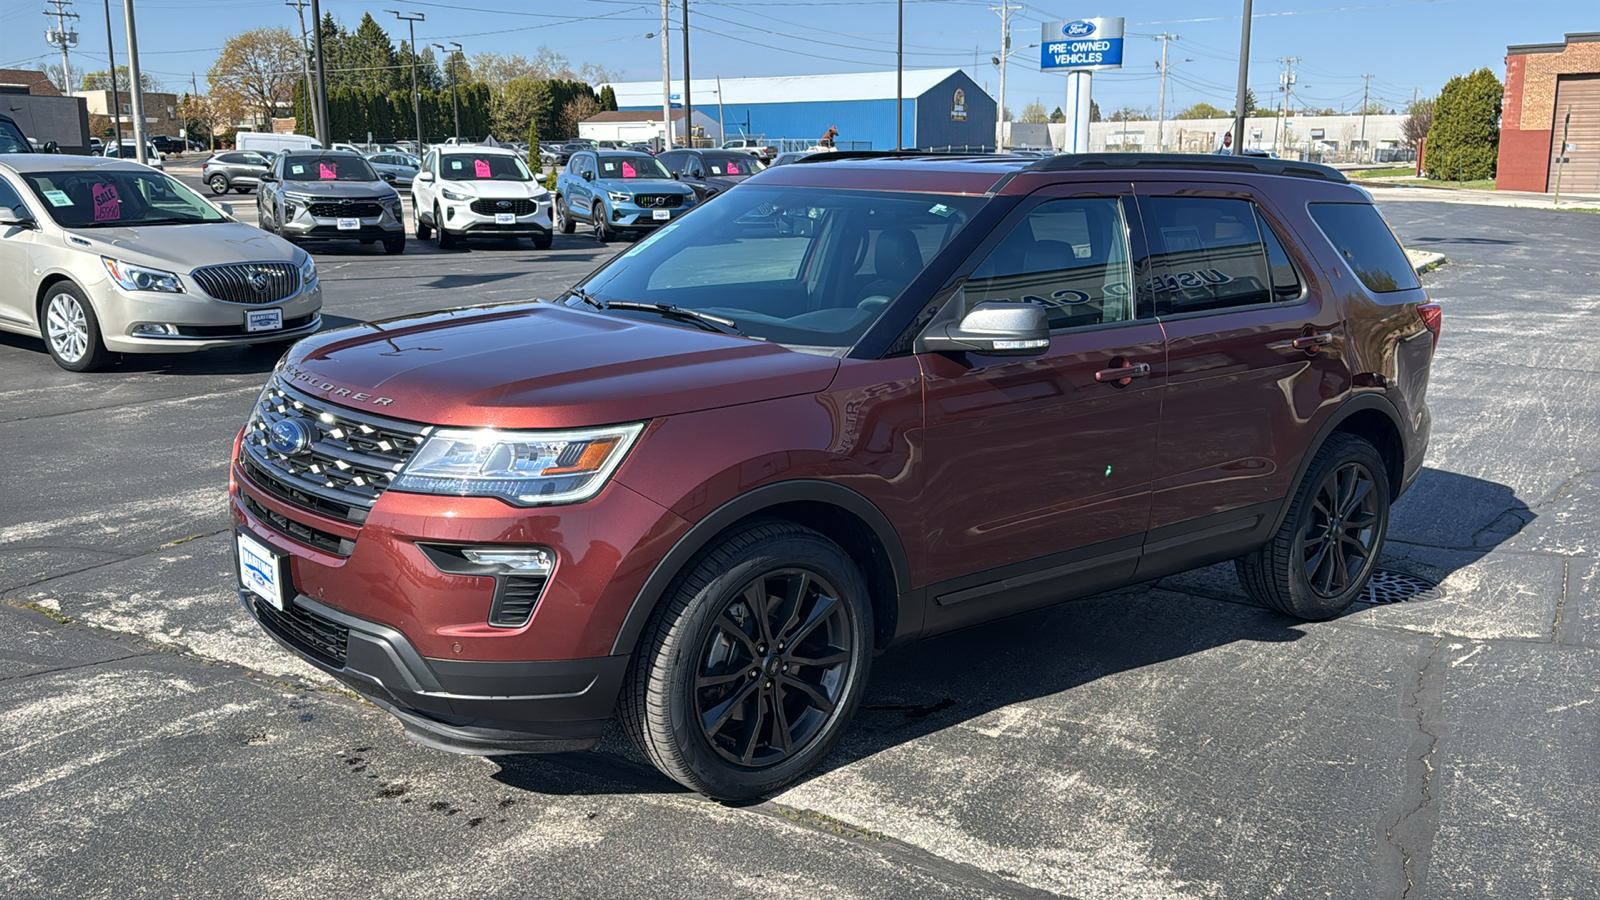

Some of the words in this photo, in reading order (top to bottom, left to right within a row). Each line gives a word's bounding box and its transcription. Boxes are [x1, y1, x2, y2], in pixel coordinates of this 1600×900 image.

[1068, 24, 1088, 34] Ford
[1048, 41, 1110, 54] PRE-OWNED
[1054, 52, 1102, 65] VEHICLES
[94, 189, 116, 206] SALE
